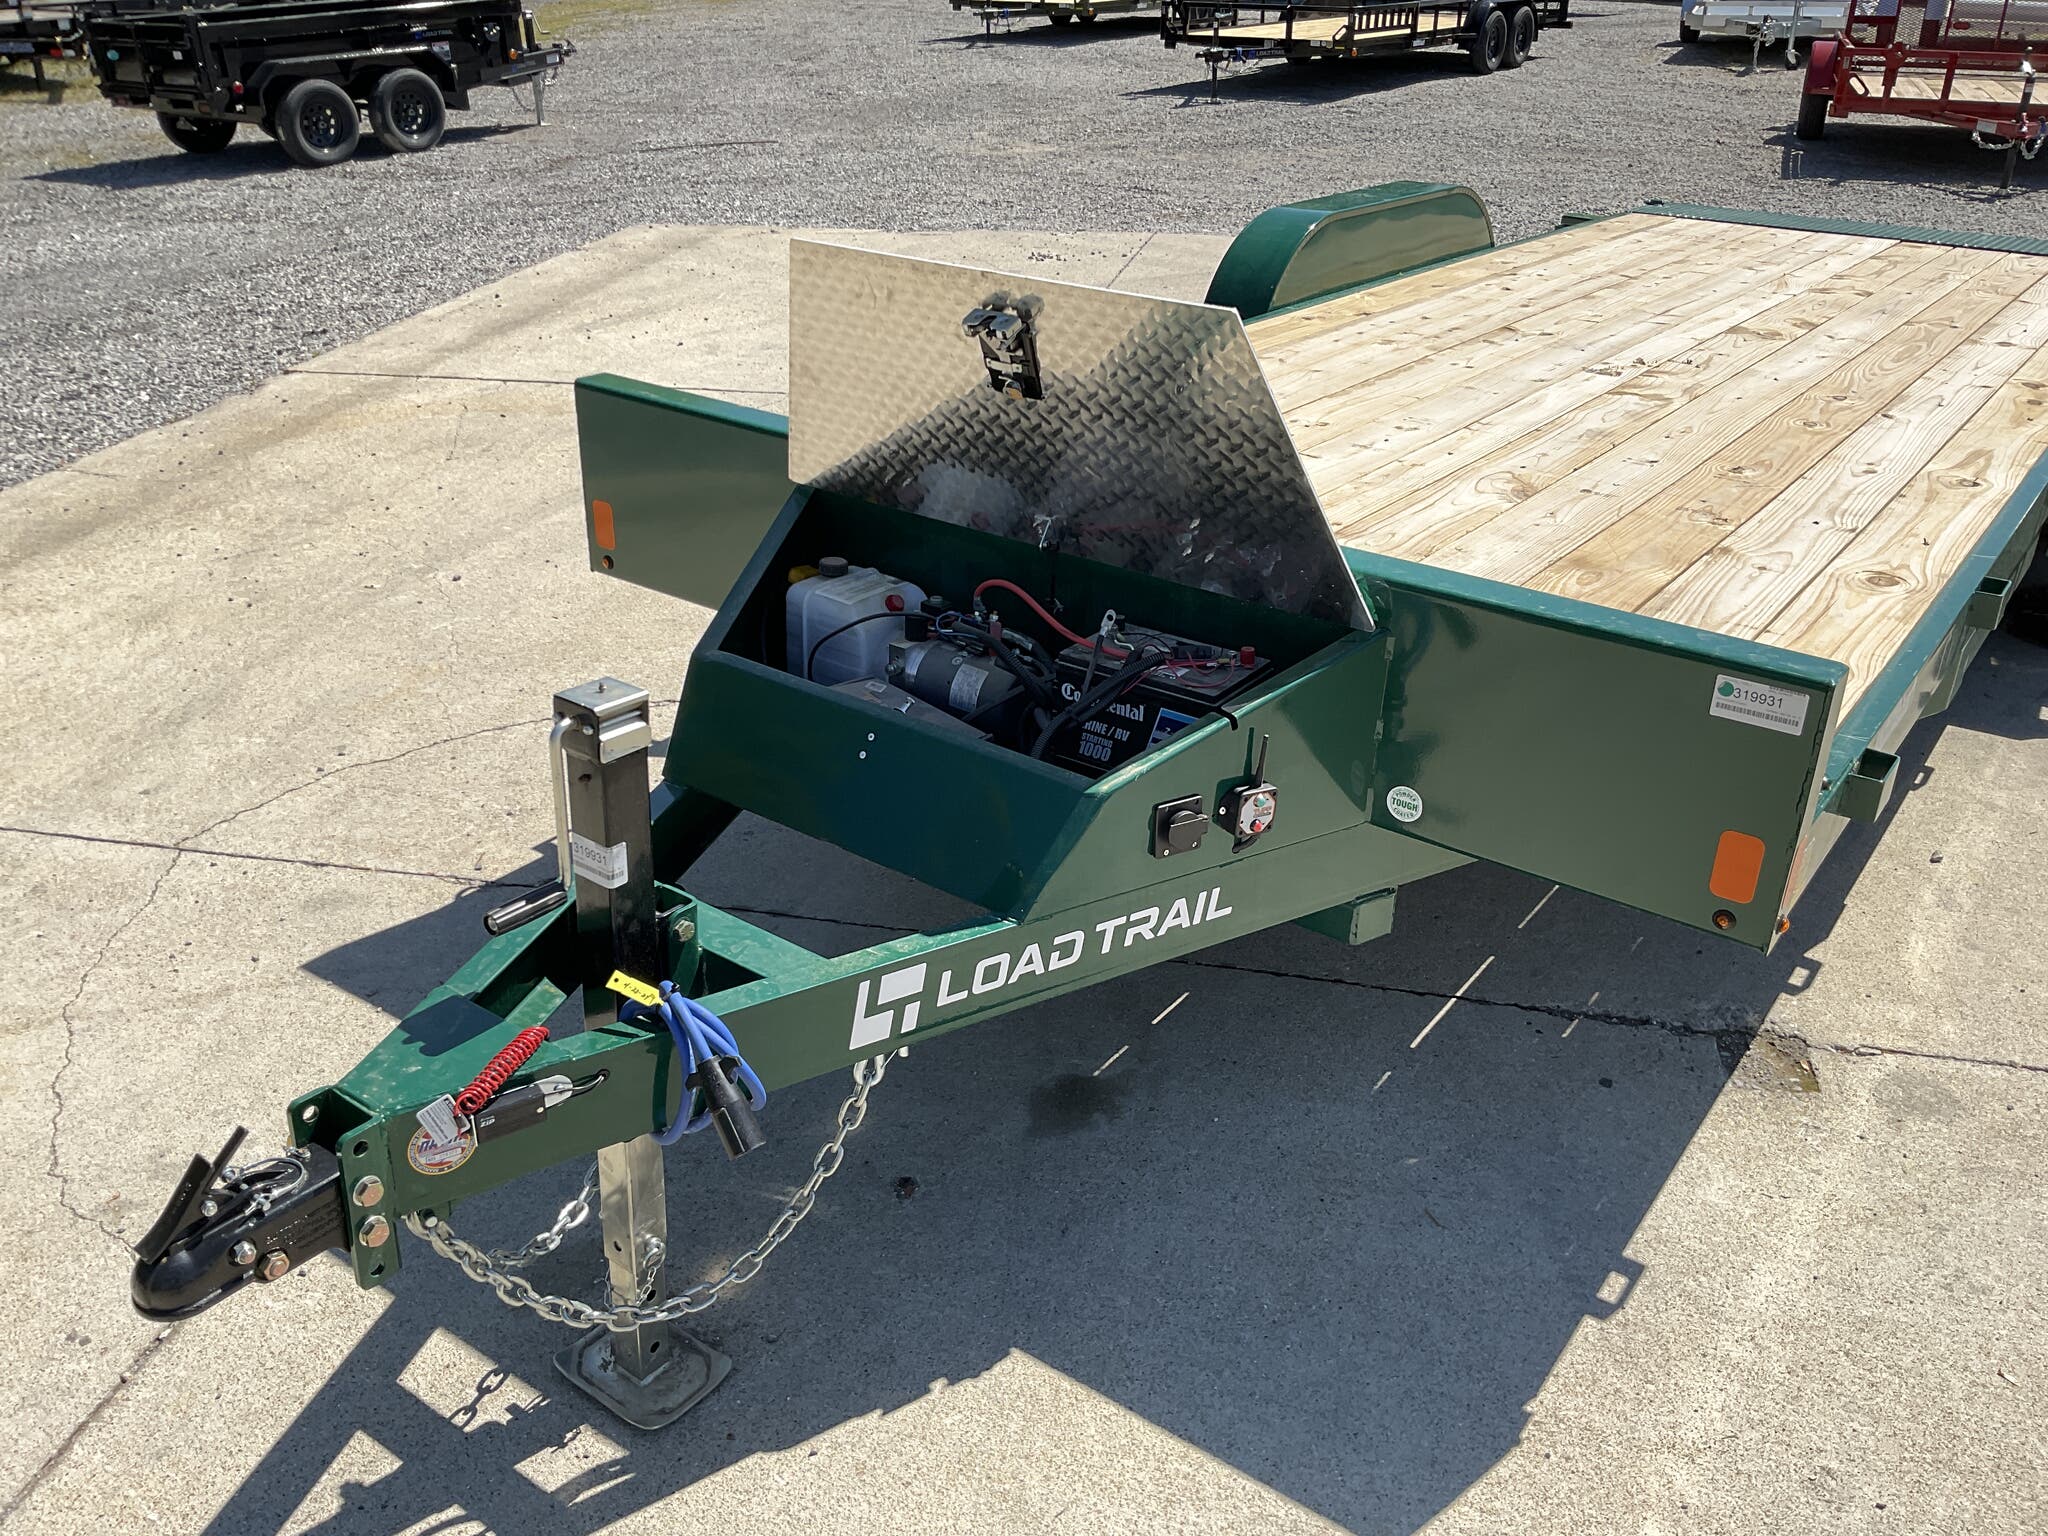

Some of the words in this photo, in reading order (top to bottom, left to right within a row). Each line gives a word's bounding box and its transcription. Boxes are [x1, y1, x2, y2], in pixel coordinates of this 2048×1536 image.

[1733, 687, 1783, 709] 319931
[1081, 732, 1113, 748] STARTING
[1114, 728, 1131, 742] RV
[1078, 741, 1112, 762] 1000
[1392, 797, 1418, 812] TOUGH
[574, 842, 607, 865] 319931
[936, 930, 1085, 1008] LOAD
[1095, 887, 1233, 955] TRAIL
